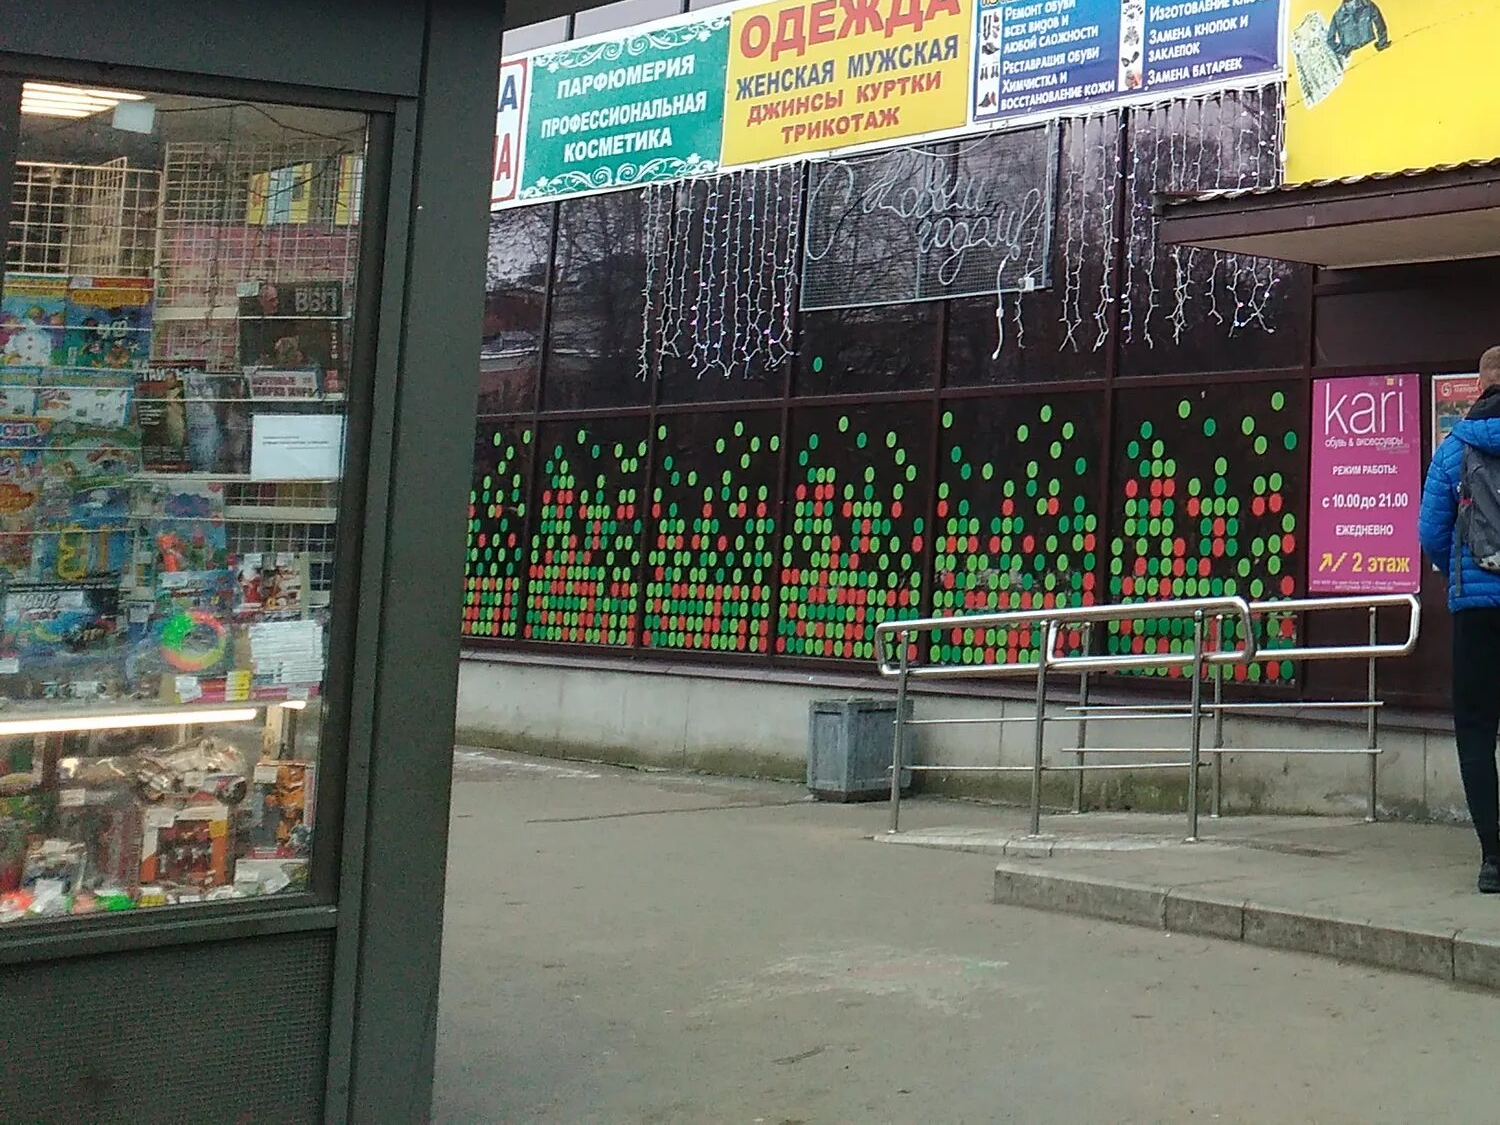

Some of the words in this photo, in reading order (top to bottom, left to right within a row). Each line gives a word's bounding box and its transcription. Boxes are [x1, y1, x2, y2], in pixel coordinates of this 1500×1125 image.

[556, 55, 695, 99] ПАРФЮМЕРИЯ
[736, 59, 835, 101] ЖЕНСКАЯ
[847, 34, 959, 79] МУЖСКАЯ
[541, 91, 707, 138] ПРОФЕССИОНАЛЬНАЯ
[747, 89, 843, 127] ДЖИНСЫ
[856, 71, 941, 104] КУРТКИ
[781, 106, 900, 144] ТРИКОТАЖ
[564, 127, 672, 163] КОСМЕТИКА
[1325, 378, 1404, 435] kari
[1332, 465, 1361, 475] РЕЖИМ
[1362, 464, 1398, 475] РАБОТЫ:
[1322, 496, 1330, 508] с
[1378, 492, 1408, 508] 21.00
[1335, 524, 1394, 537] ЕЖЕДНЕВНО
[1352, 552, 1362, 572] 2
[1367, 557, 1410, 572] этаж
